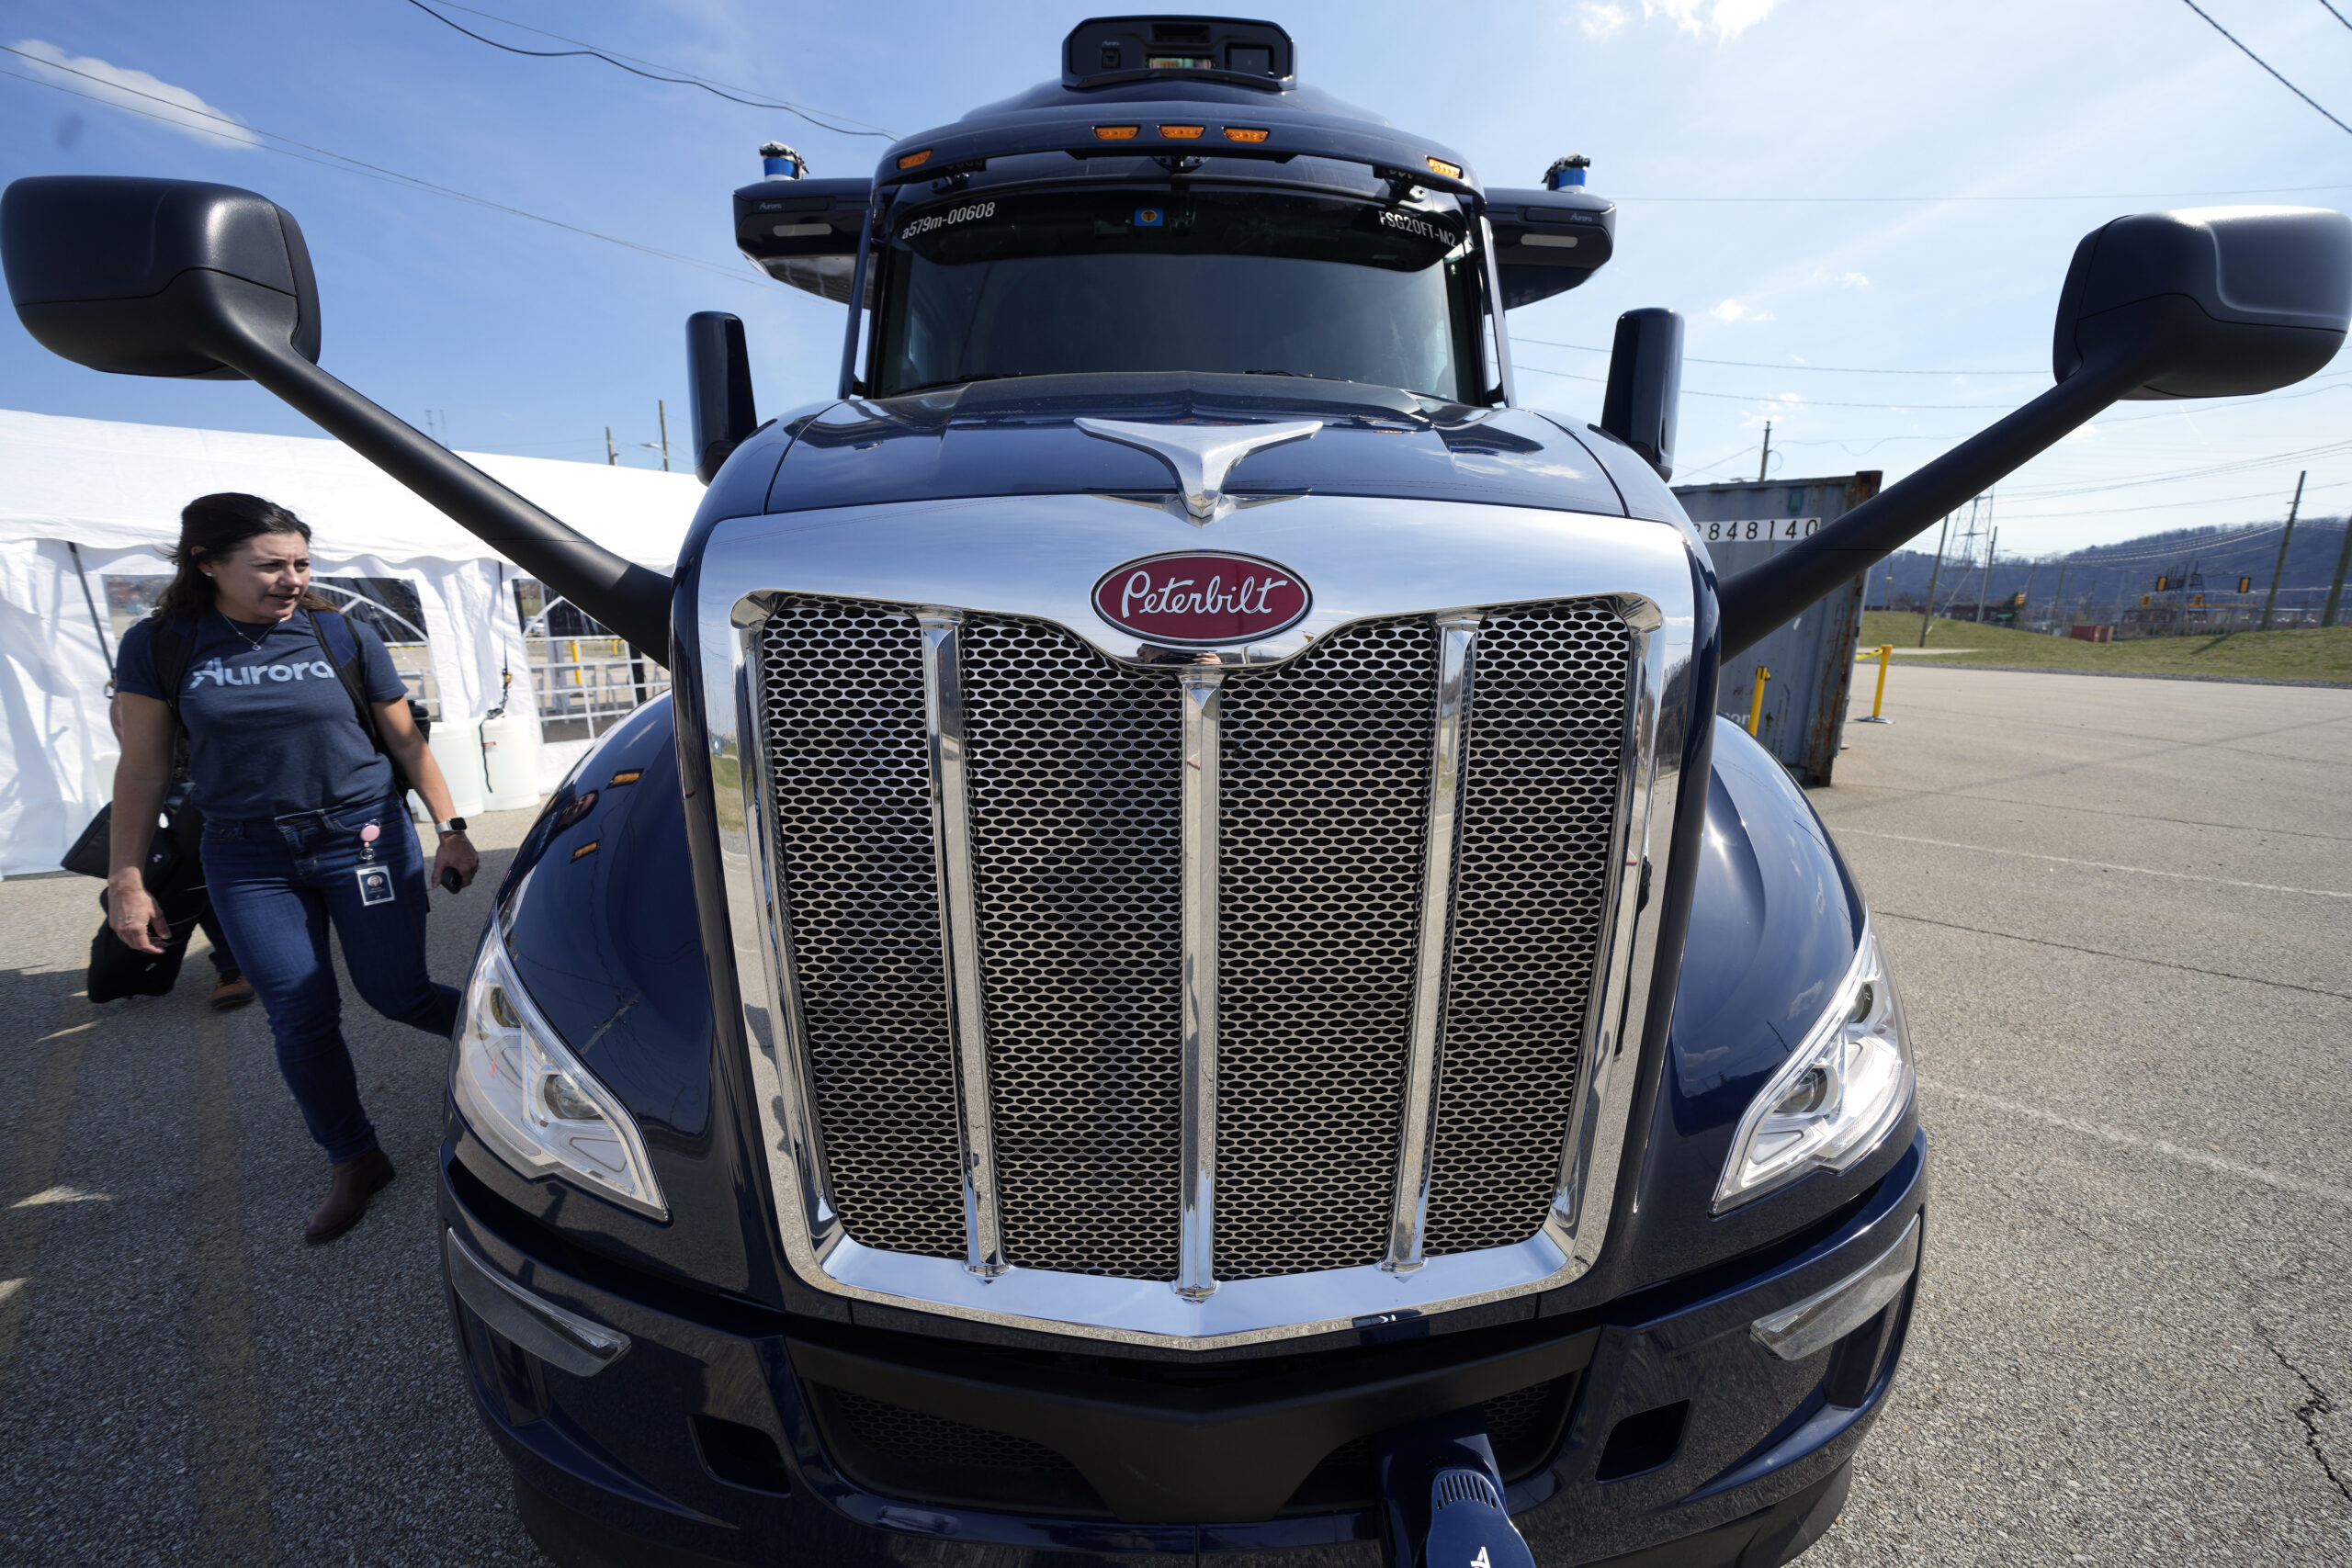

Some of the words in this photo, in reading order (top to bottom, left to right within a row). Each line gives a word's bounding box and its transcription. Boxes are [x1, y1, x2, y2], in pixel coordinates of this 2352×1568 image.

[759, 202, 782, 210] Aurora
[901, 201, 996, 240] a579m-00608
[1570, 212, 1593, 222] Aurora
[1378, 210, 1456, 248] FSG20FT-M2
[1121, 570, 1288, 619] Peterbilt
[188, 657, 335, 689] Aurora
